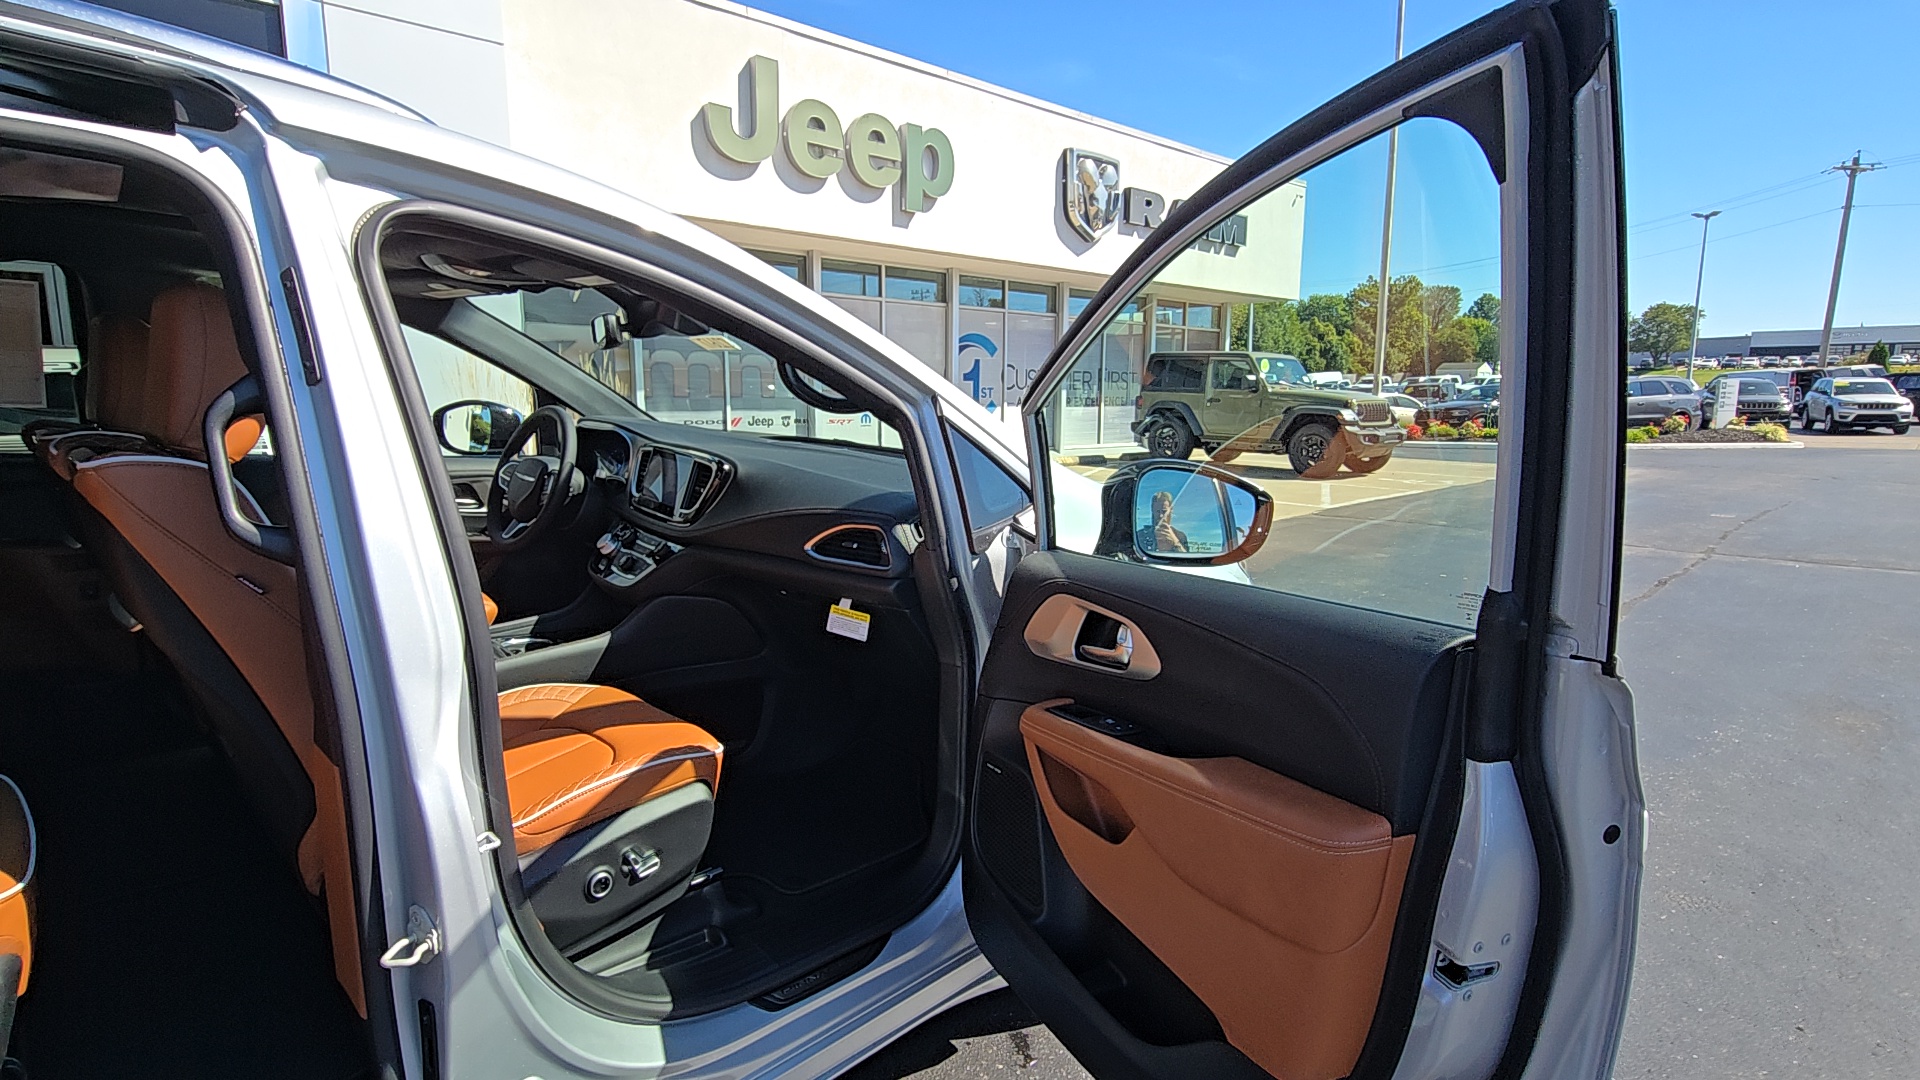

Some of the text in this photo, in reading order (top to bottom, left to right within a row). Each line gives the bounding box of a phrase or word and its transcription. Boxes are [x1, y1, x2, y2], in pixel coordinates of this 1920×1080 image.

[702, 54, 955, 213] Jeep
[1123, 186, 1248, 247] RM
[748, 416, 774, 428] Jeep
